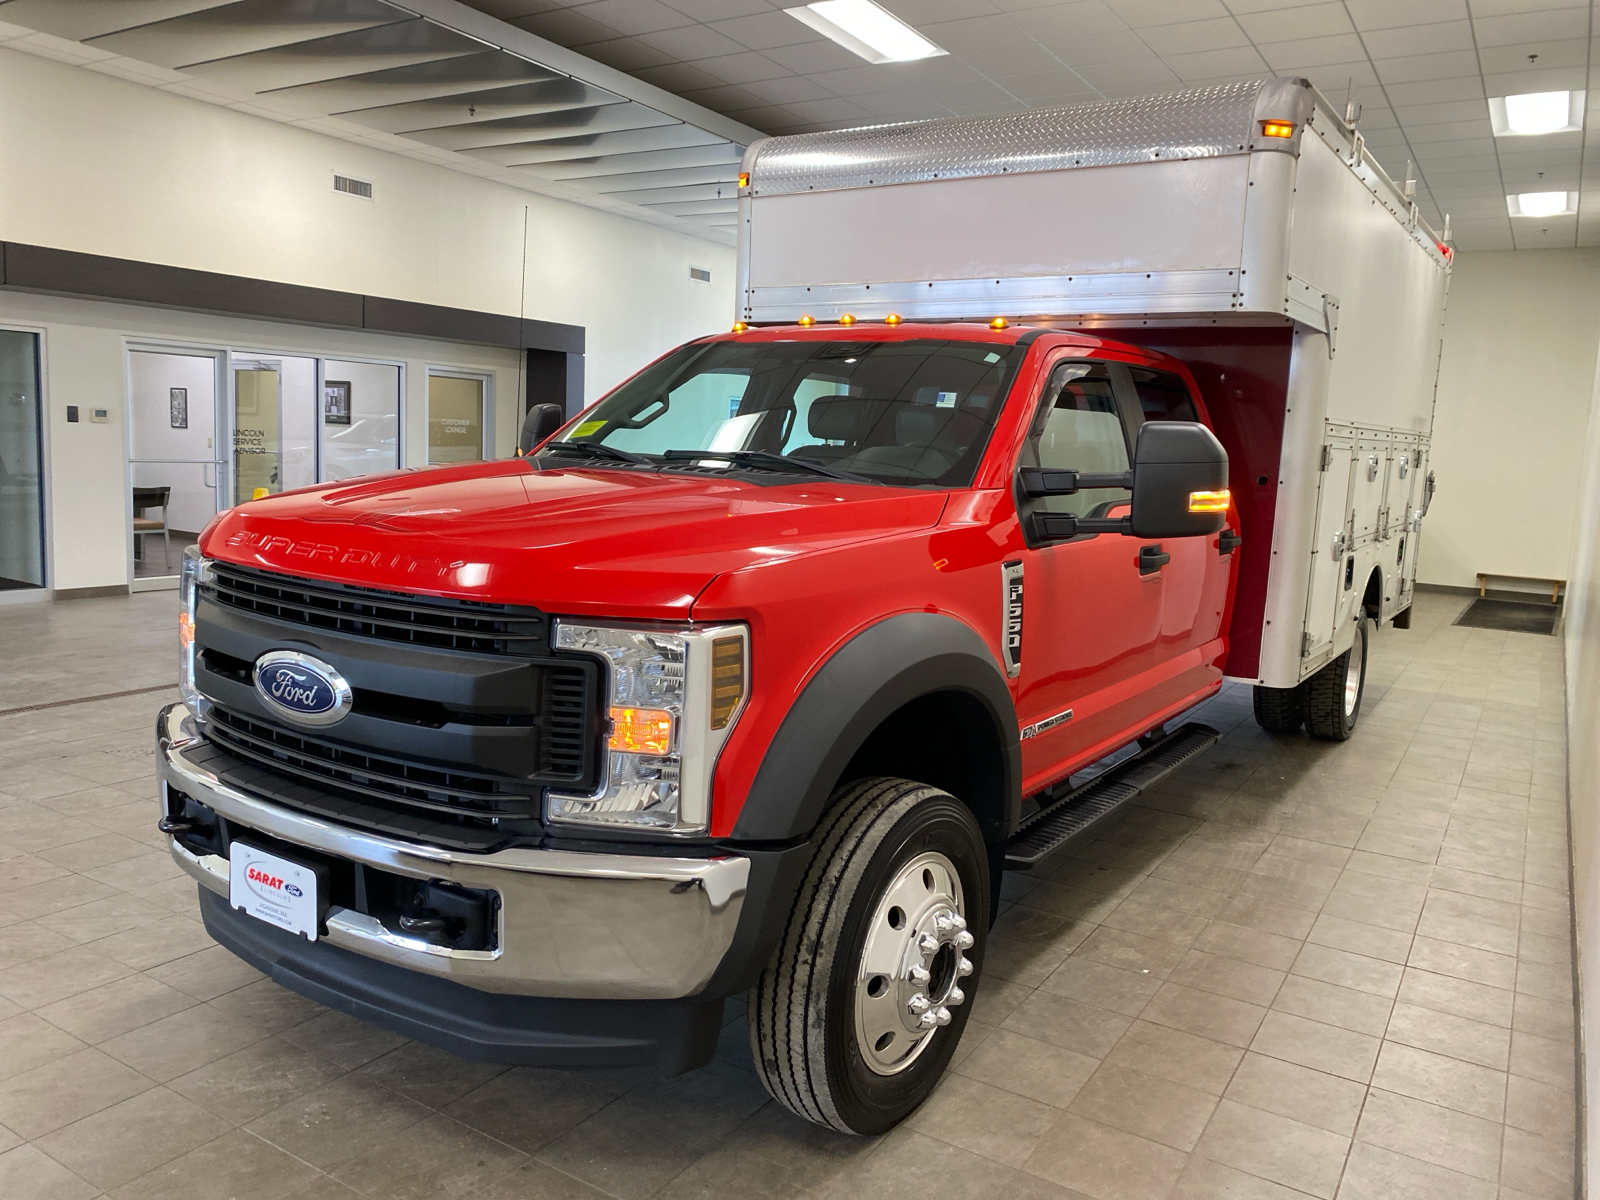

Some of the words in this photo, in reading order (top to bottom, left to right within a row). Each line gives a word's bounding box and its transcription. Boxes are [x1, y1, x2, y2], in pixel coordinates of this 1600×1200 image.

[442, 418, 470, 426] CUSTOMER
[233, 429, 264, 437] LINCOLN
[445, 426, 467, 434] LOUNGE
[233, 438, 262, 446] SERVICE
[233, 447, 266, 455] ADVISOR
[226, 530, 339, 561] SUPER
[341, 548, 464, 577] DUTY
[271, 669, 317, 707] Ford
[248, 867, 284, 890] SARAT
[285, 884, 303, 897] Ford
[264, 887, 288, 901] LINCOLN
